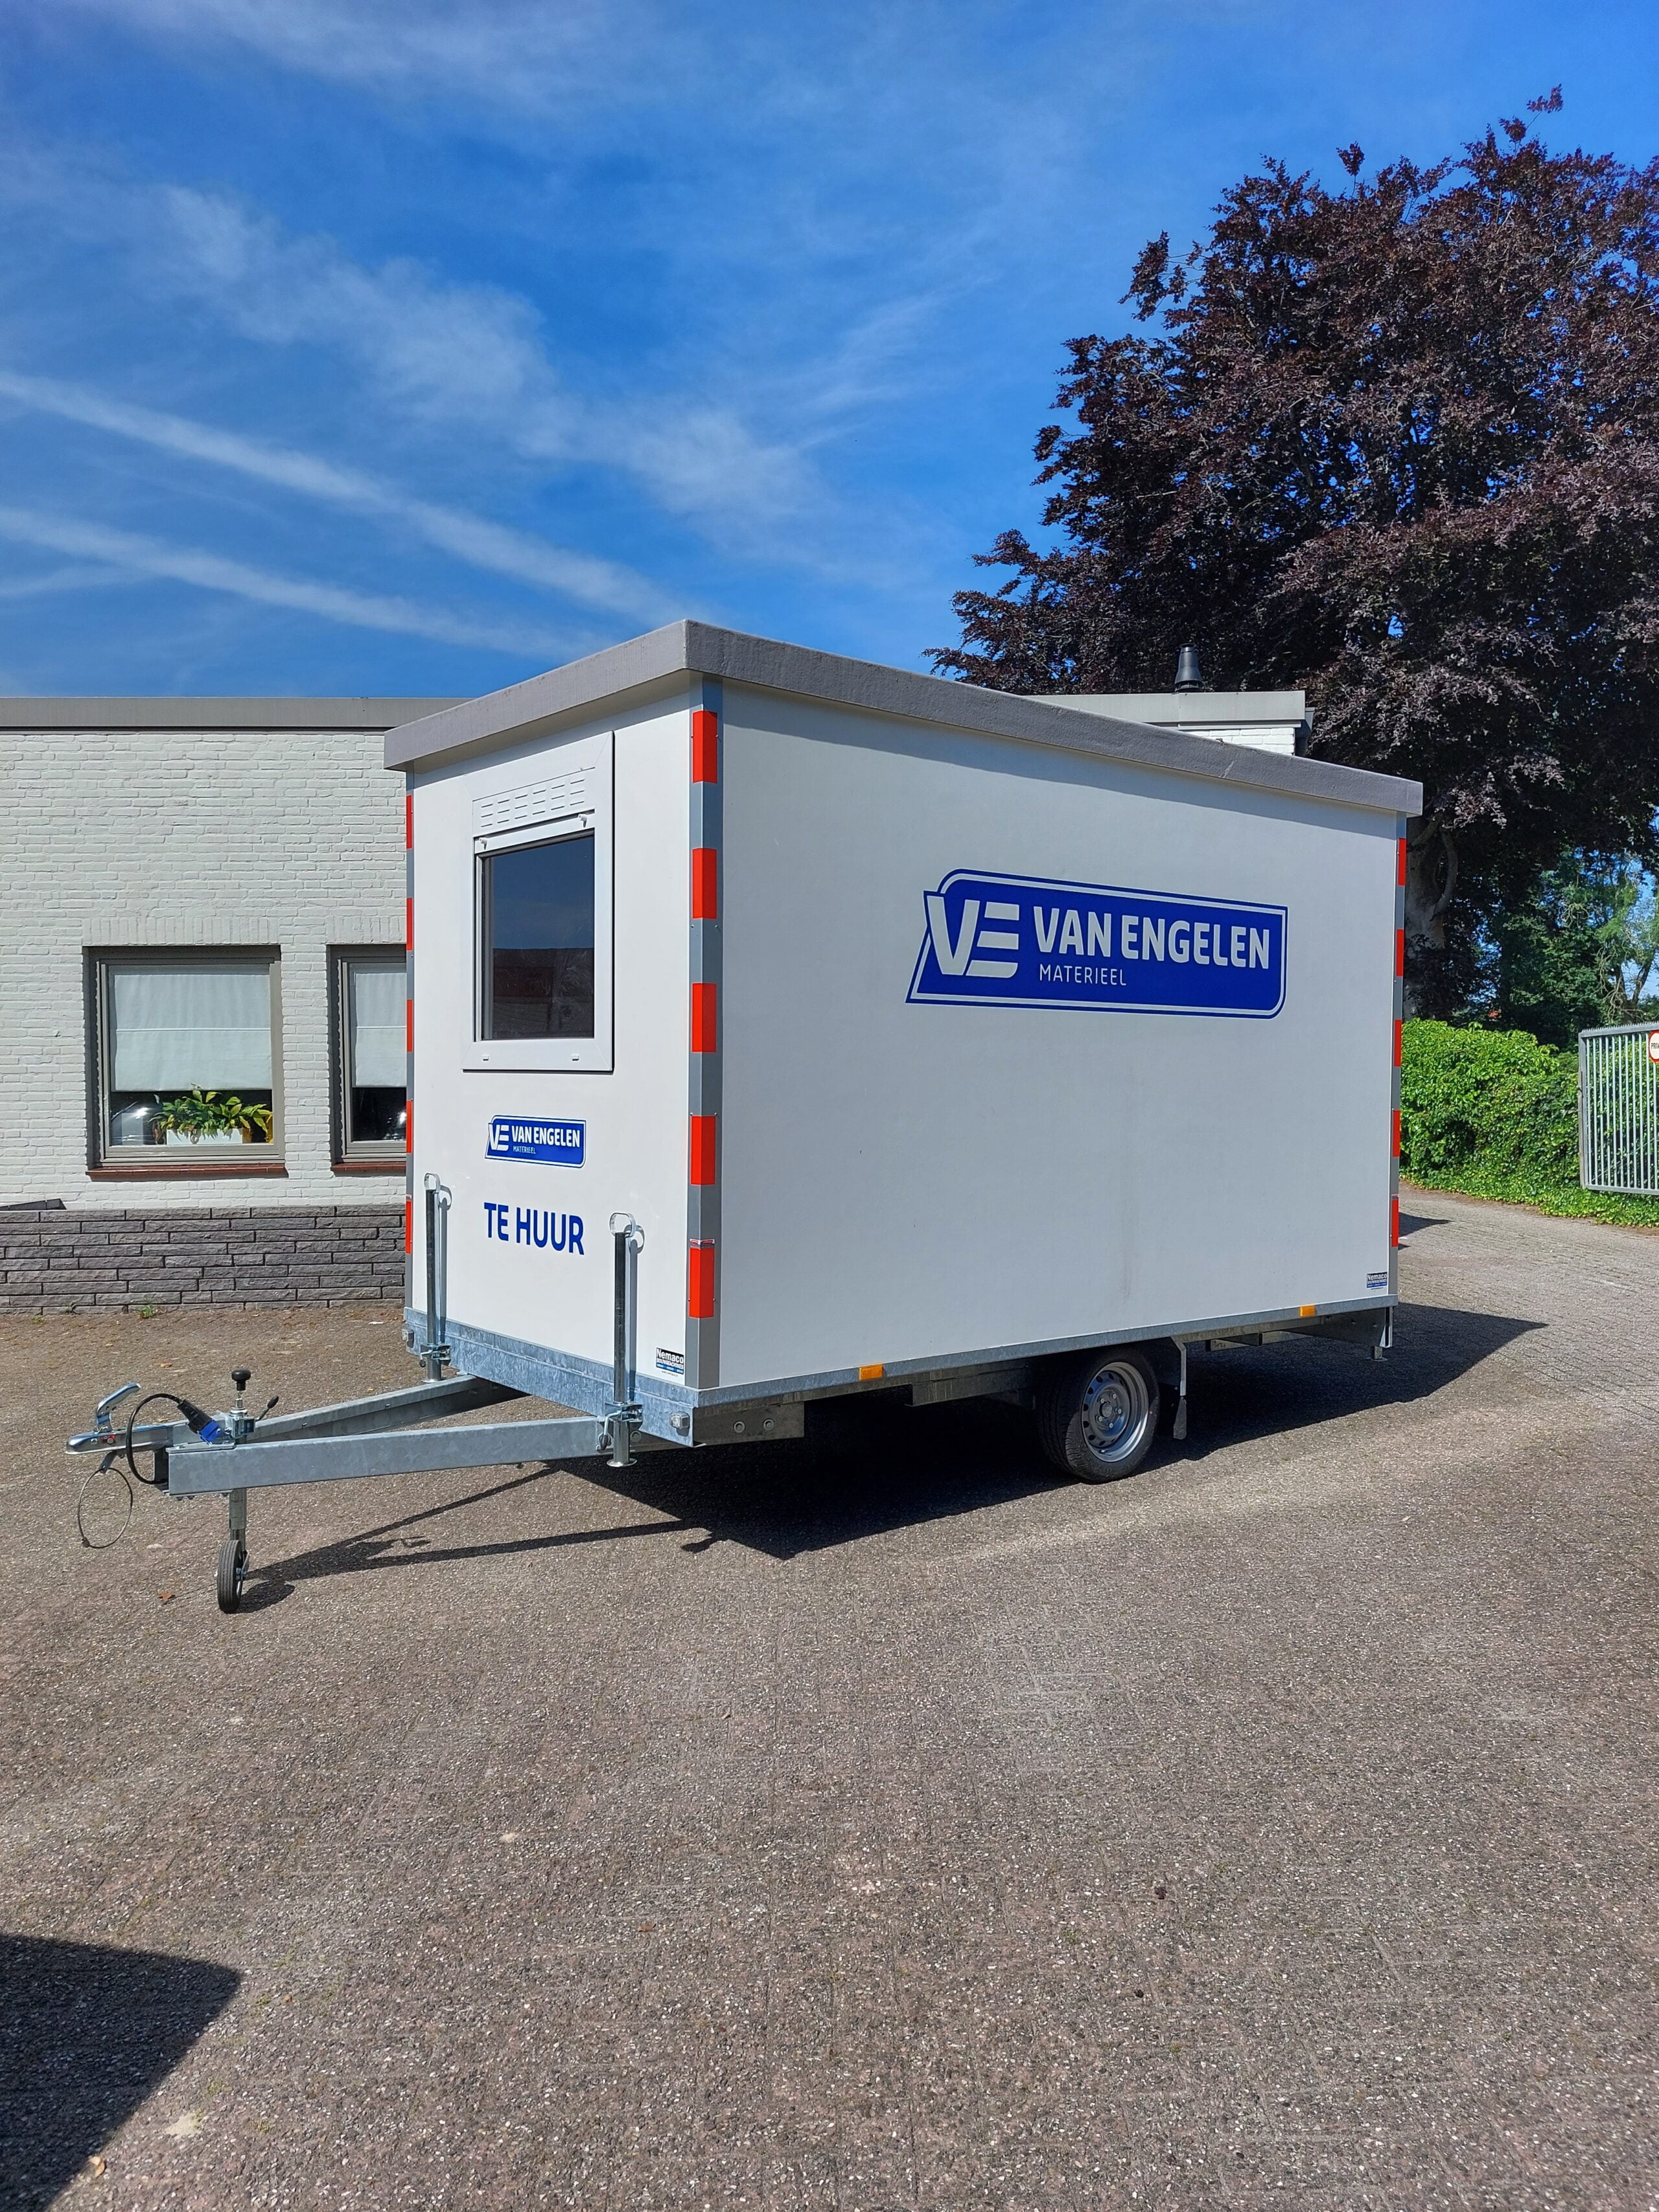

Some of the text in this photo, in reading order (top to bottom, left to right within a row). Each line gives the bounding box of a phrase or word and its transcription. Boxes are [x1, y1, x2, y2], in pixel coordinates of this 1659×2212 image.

[1033, 906, 1270, 970] VAN ENGELEN
[1039, 963, 1127, 986] MATERIEEL
[511, 1125, 581, 1148] VAN ENGELEN
[513, 1145, 537, 1154] MATERIEEL
[484, 1202, 585, 1255] TE HUUR
[656, 1348, 684, 1364] Nemaco
